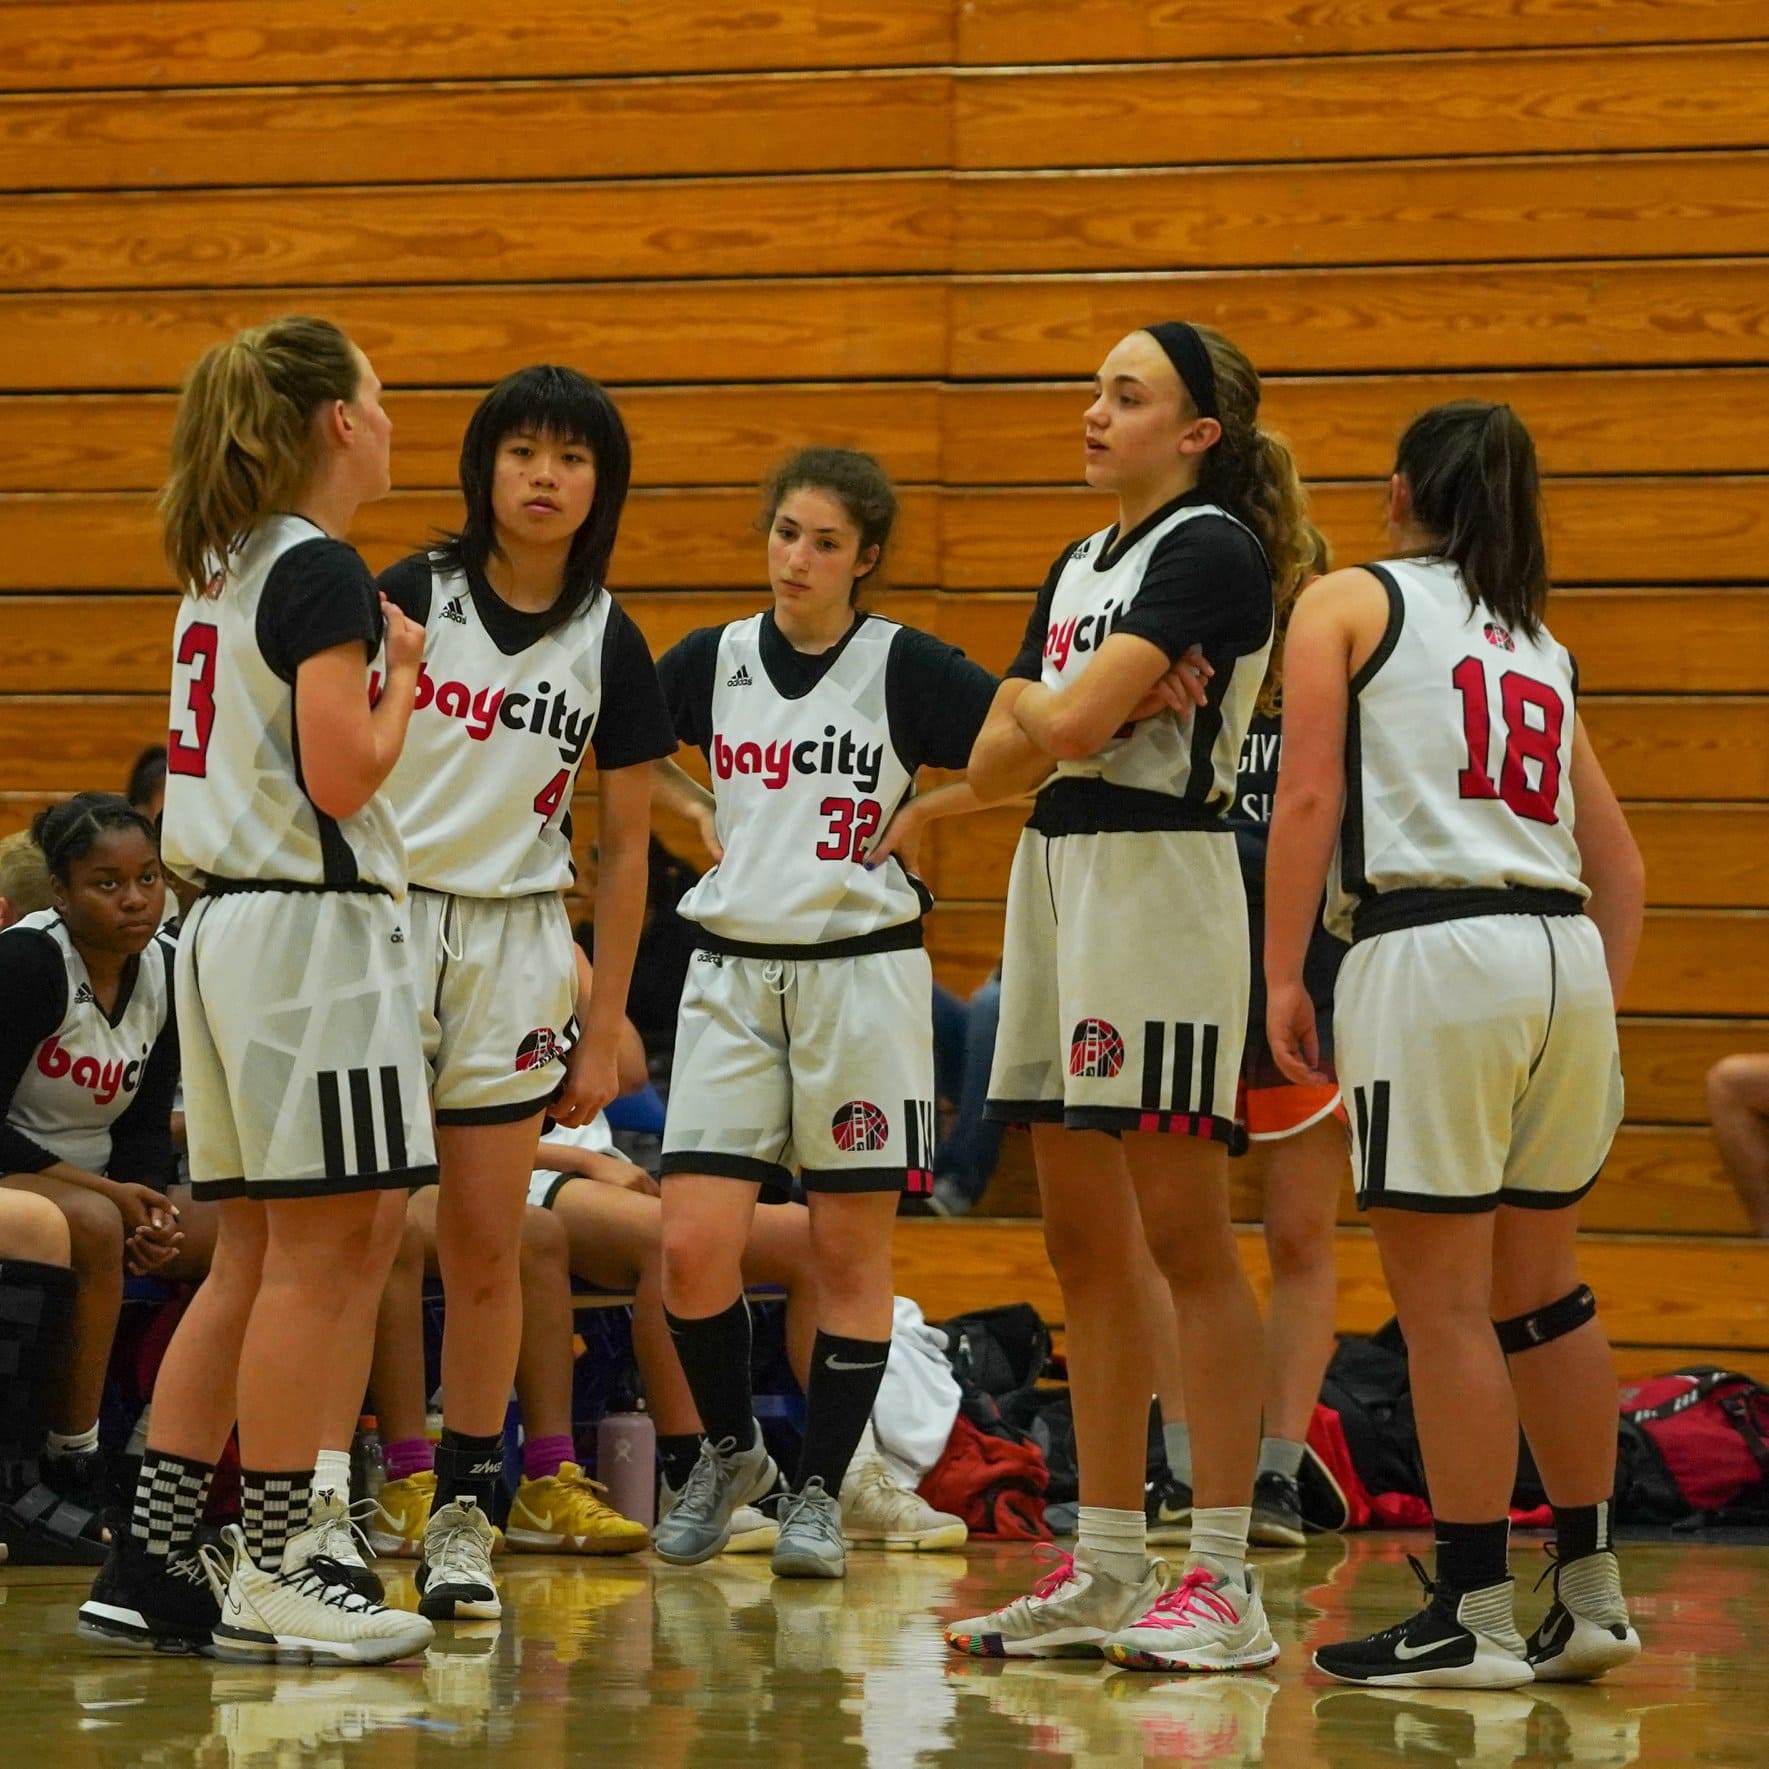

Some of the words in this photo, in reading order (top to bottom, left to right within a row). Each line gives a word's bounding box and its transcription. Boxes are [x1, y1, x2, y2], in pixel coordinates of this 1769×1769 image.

[168, 620, 218, 779] 3
[413, 661, 596, 765] baycity
[727, 676, 752, 687] adidas
[714, 724, 884, 795] baycity
[1452, 655, 1564, 826] 18
[533, 767, 571, 837] 4
[816, 796, 883, 865] 32
